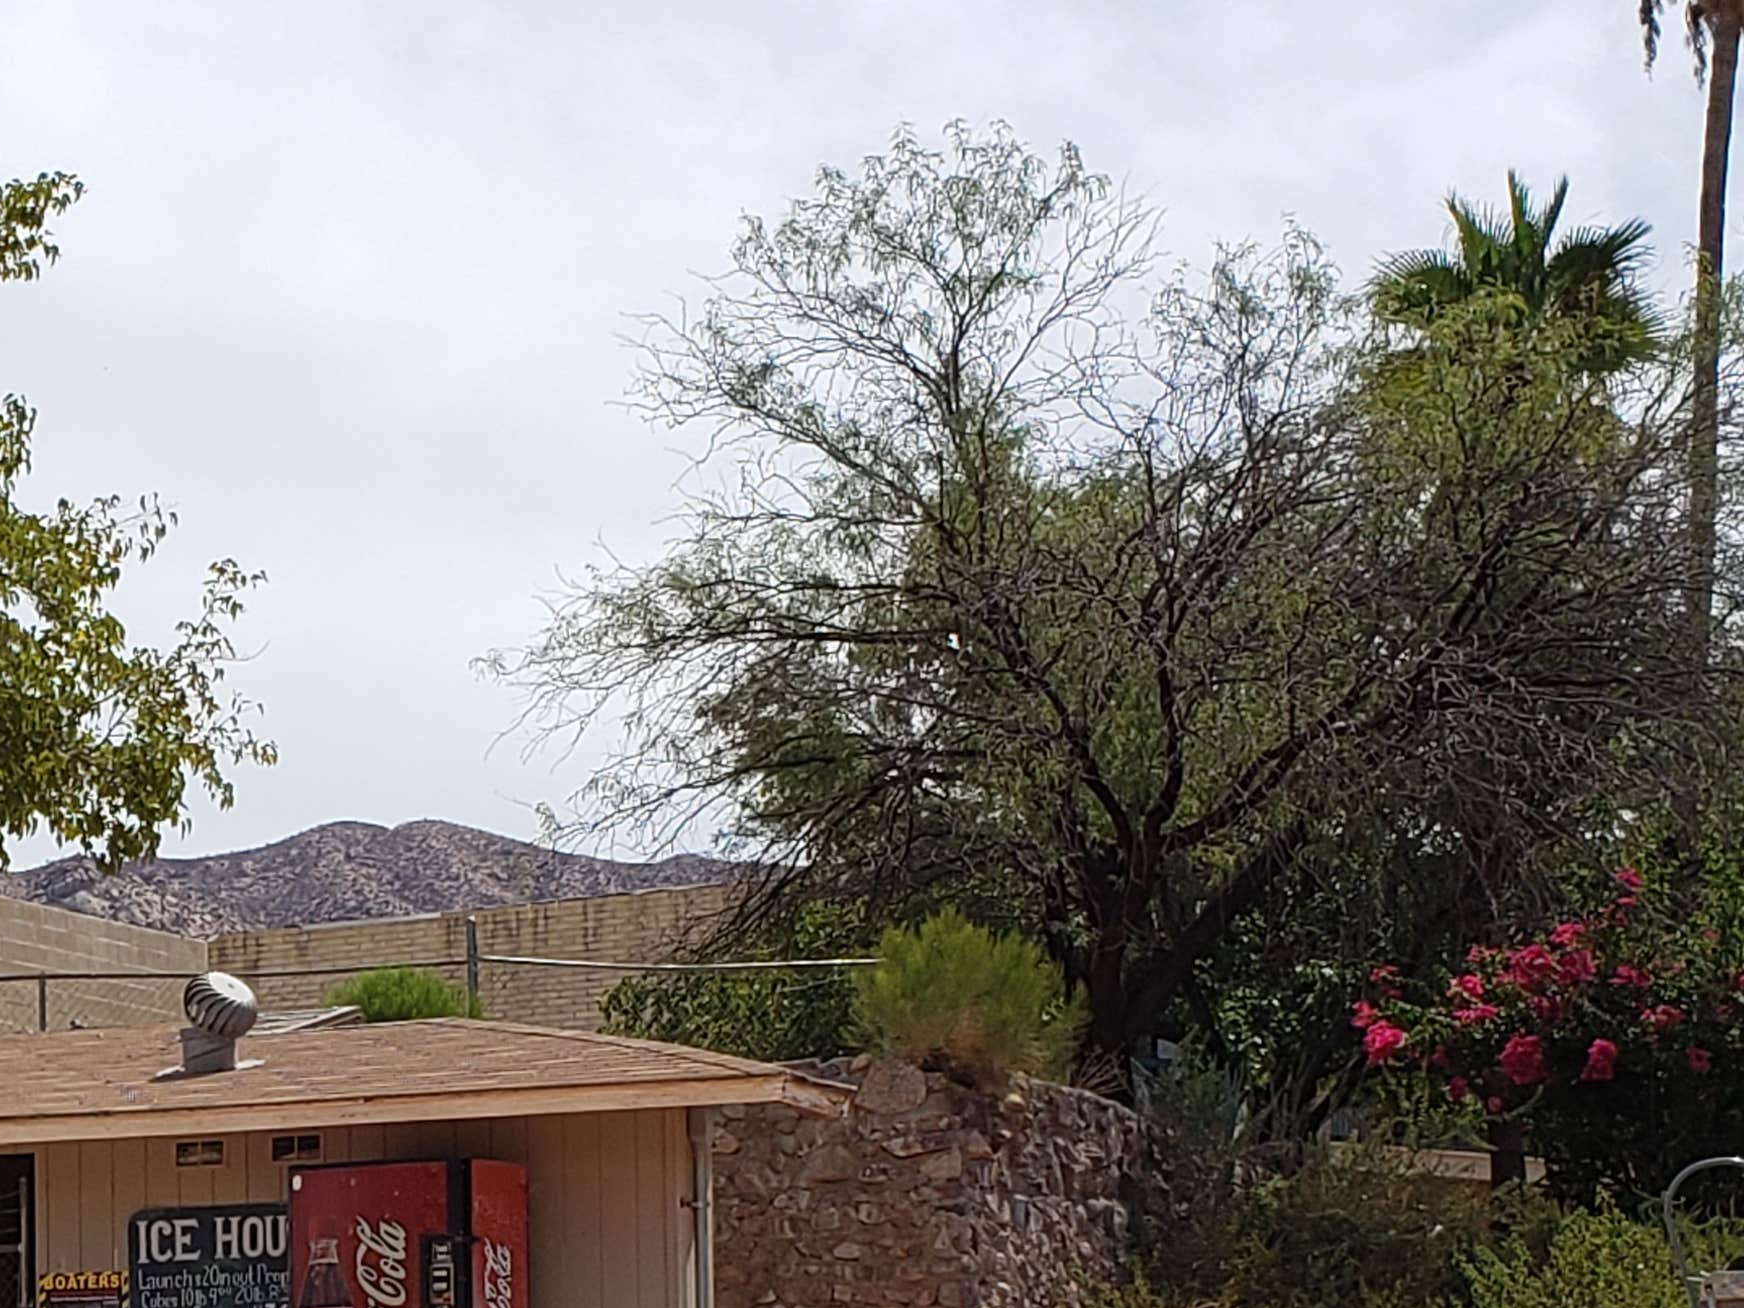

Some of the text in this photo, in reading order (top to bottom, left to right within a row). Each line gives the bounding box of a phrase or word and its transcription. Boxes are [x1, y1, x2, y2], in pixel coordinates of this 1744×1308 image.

[136, 1215, 290, 1264] ICE HOU
[138, 1267, 193, 1291] Launch
